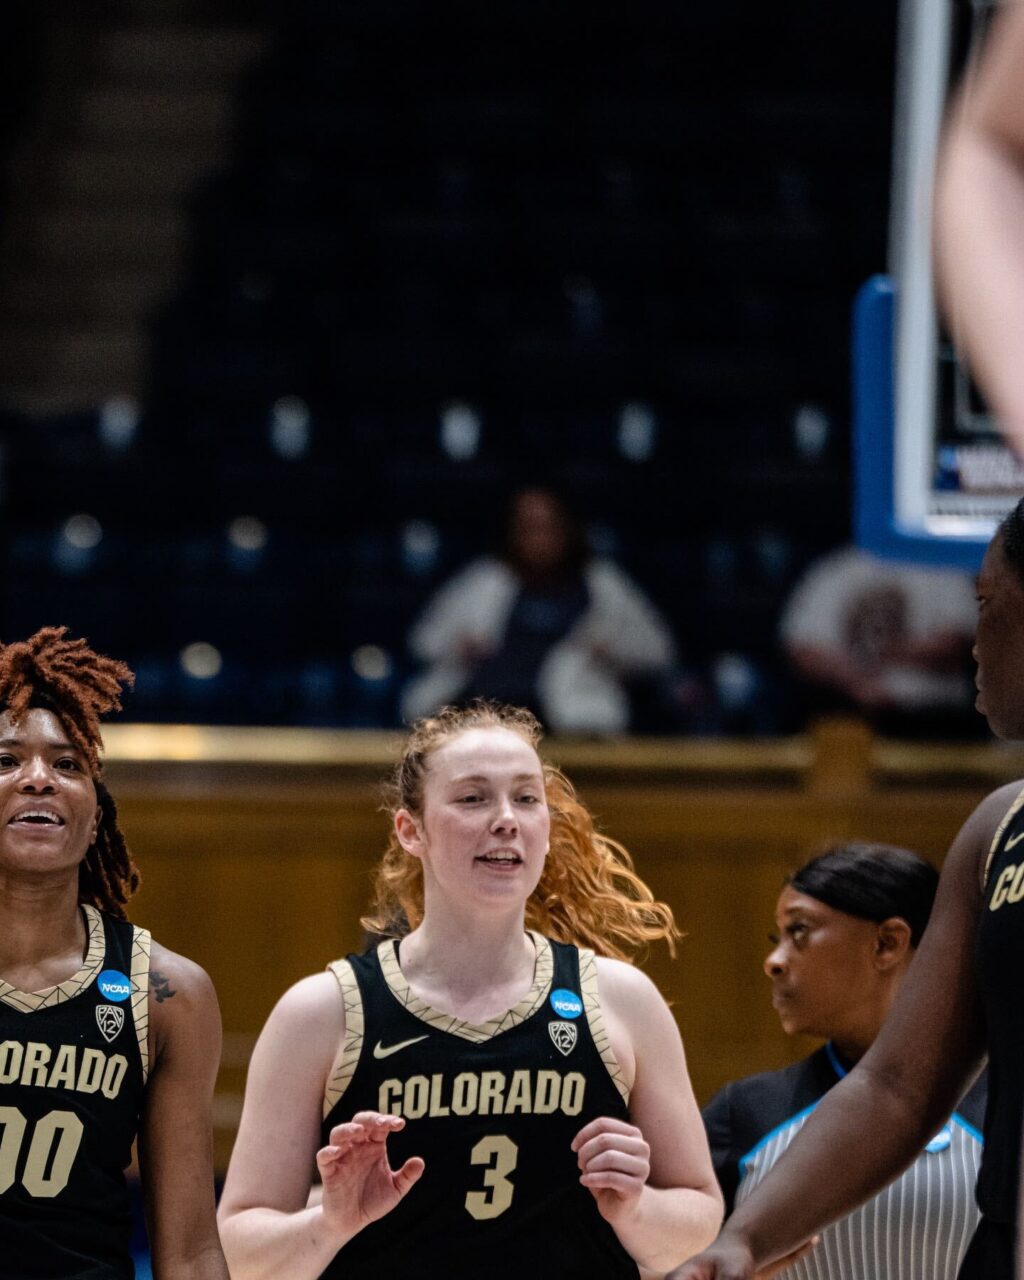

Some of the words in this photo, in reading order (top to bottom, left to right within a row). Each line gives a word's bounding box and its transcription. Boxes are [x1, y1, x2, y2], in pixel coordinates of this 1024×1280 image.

[102, 983, 130, 994] NCAA
[554, 1001, 581, 1013] NCAA
[103, 1019, 116, 1034] 12
[557, 1035, 571, 1048] 12
[378, 1069, 586, 1120] COLORADO
[464, 1134, 519, 1221] 3
